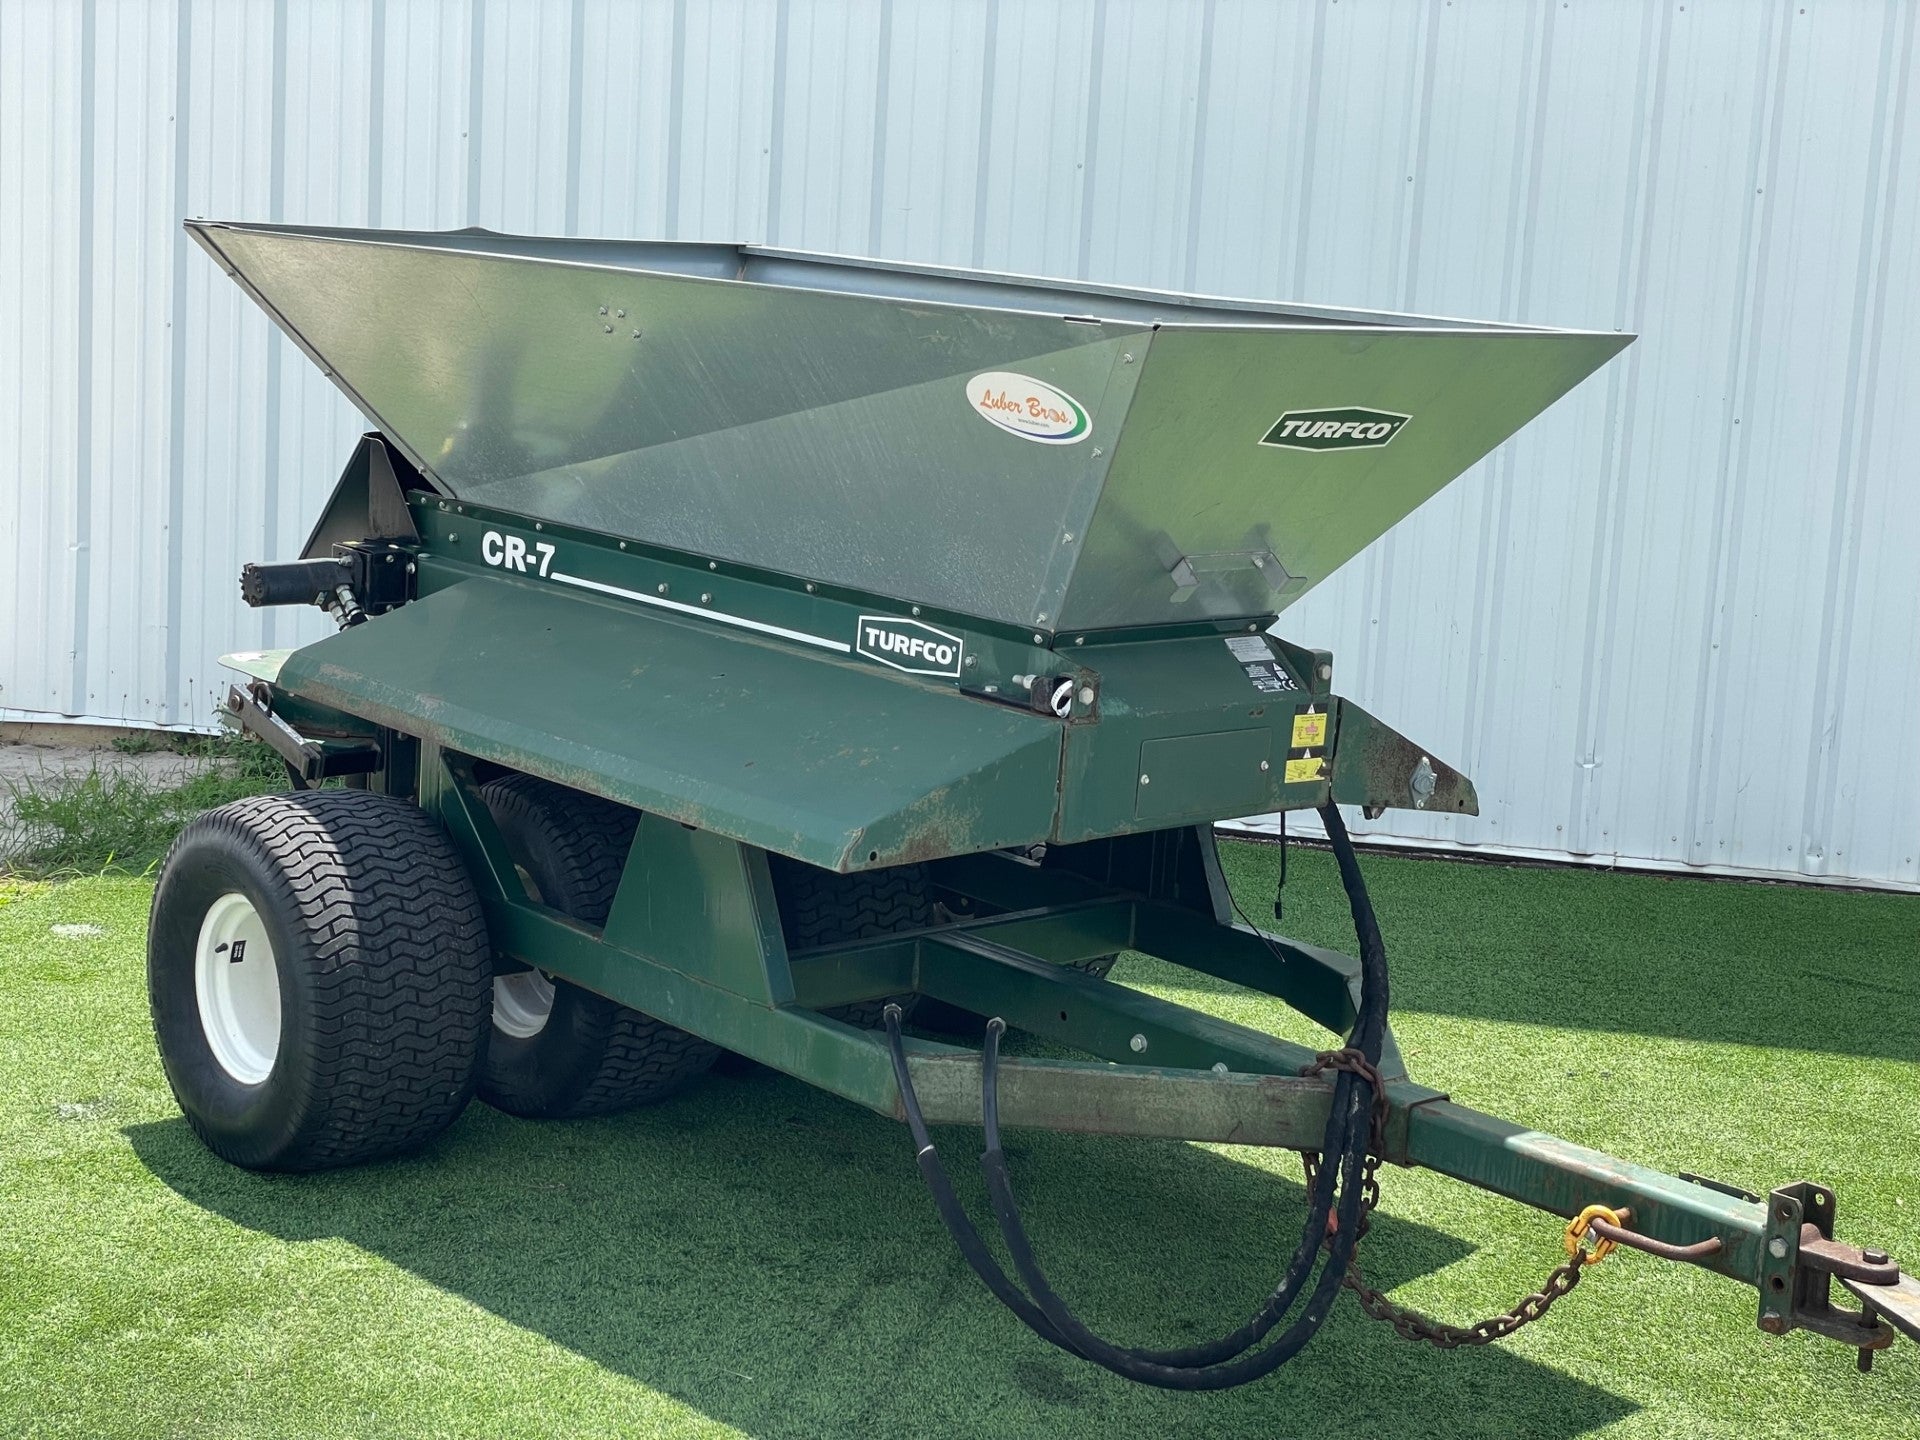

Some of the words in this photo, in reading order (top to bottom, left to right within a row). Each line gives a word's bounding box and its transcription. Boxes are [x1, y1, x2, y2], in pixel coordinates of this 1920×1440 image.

[980, 389, 1022, 415] Luber
[1026, 397, 1072, 425] Bros.
[1280, 421, 1392, 439] TURFCO
[482, 531, 556, 577] CR-7
[865, 627, 953, 665] TURFCO
